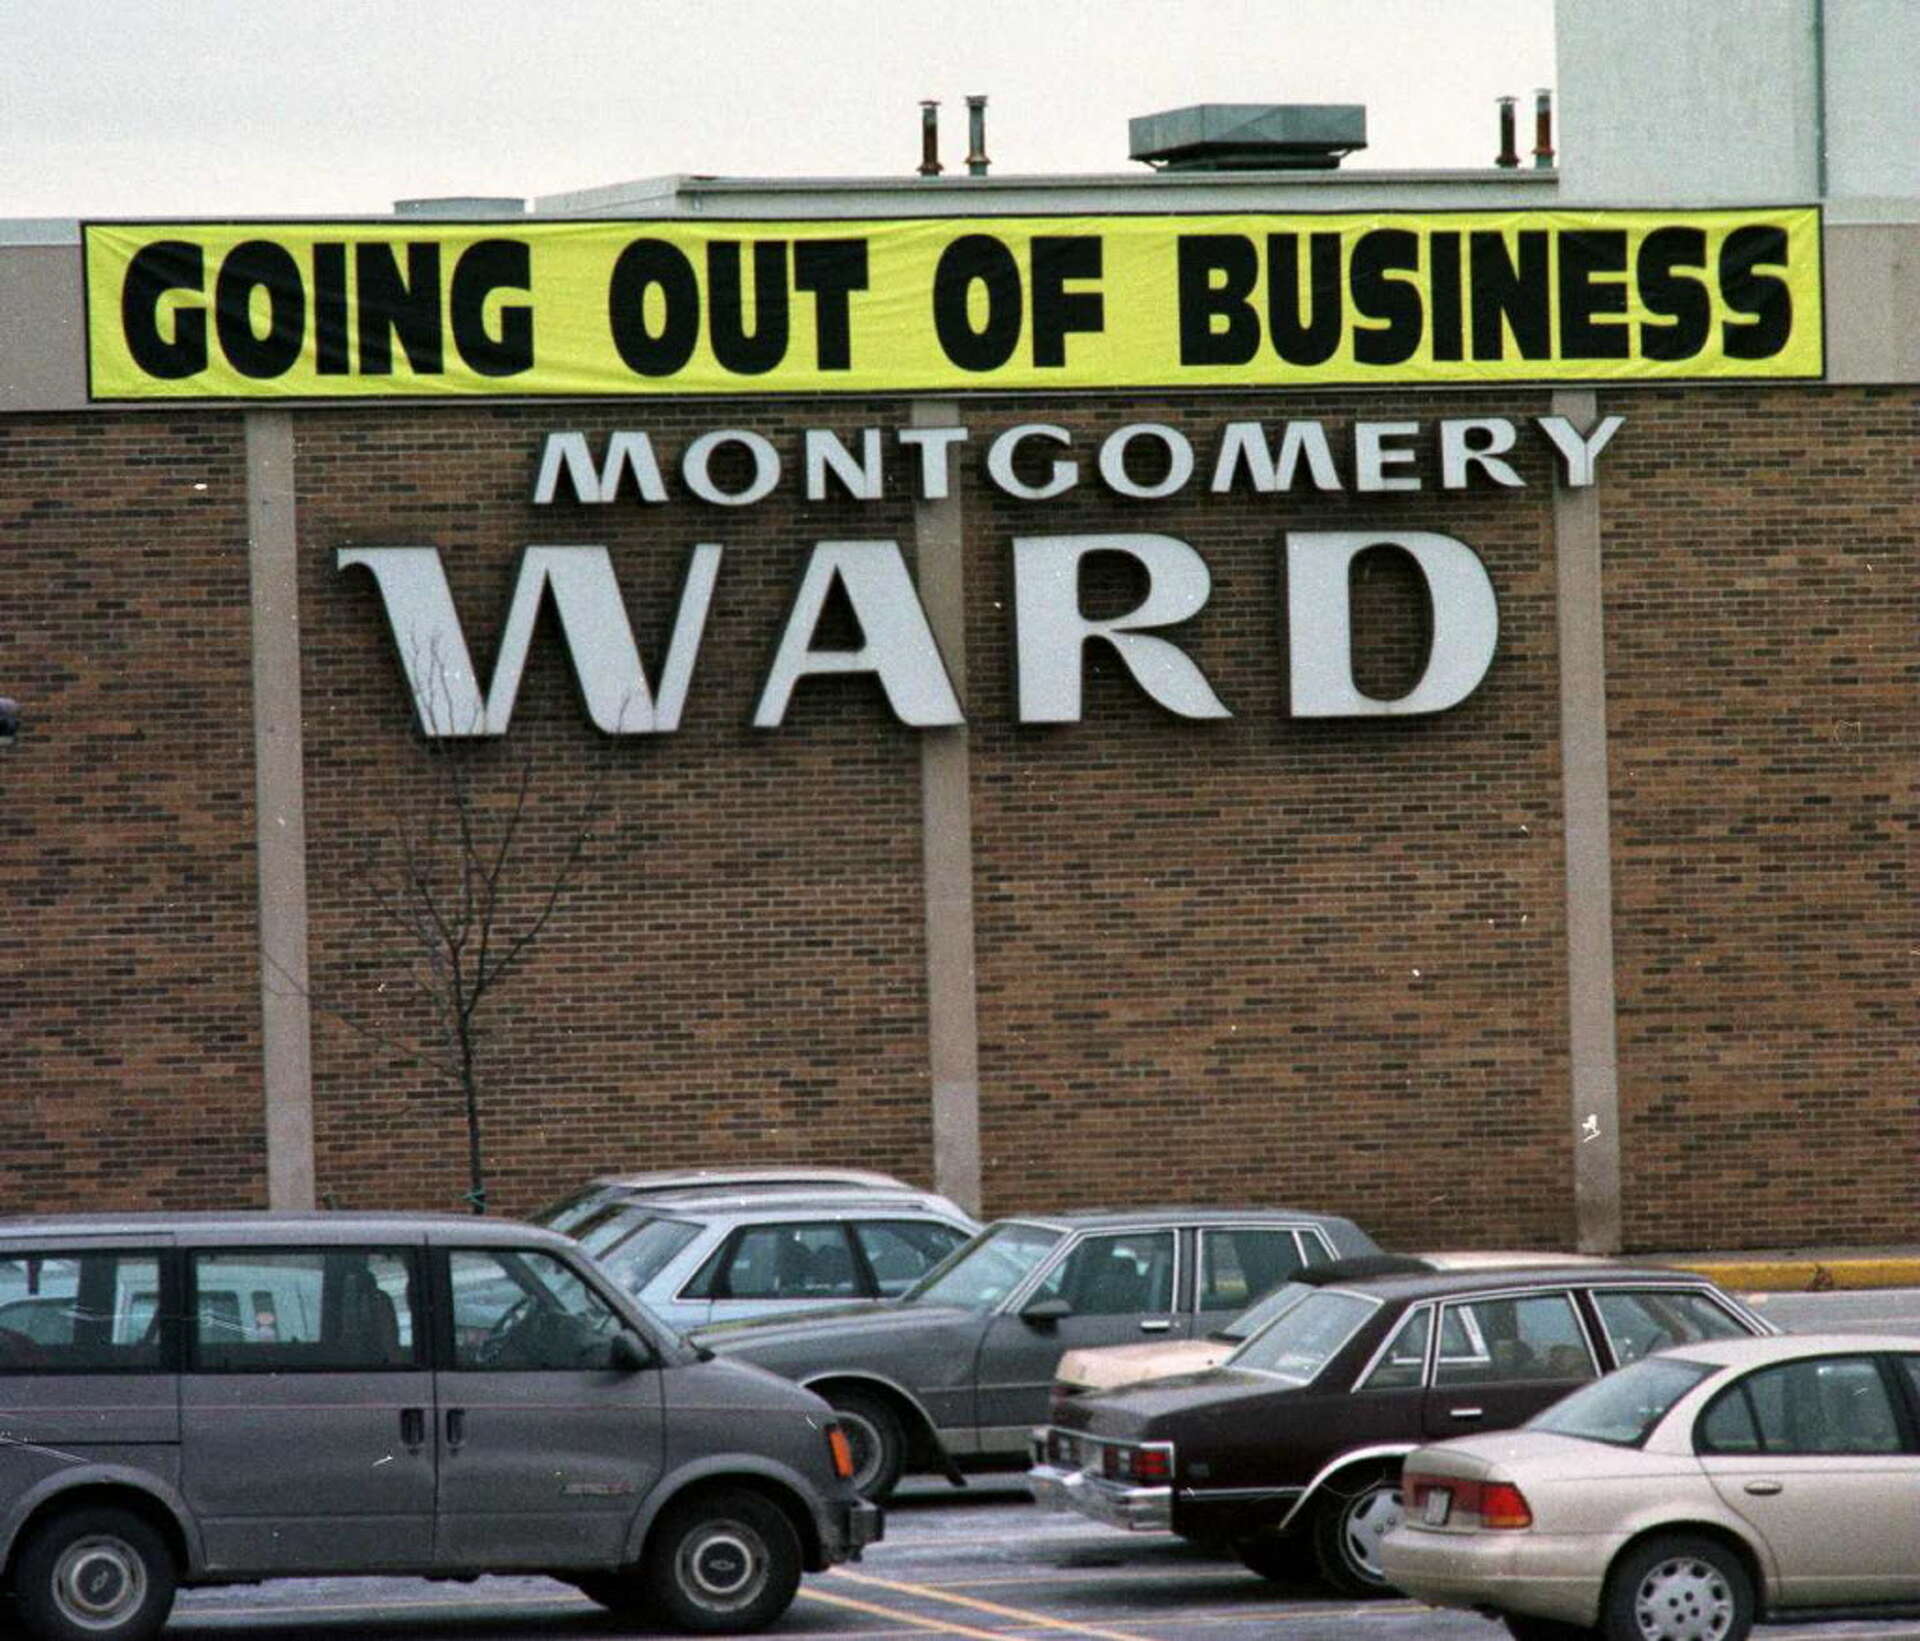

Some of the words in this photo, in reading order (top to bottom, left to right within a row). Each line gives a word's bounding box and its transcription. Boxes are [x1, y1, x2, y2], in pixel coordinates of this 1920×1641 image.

[122, 239, 534, 380] GOING
[609, 237, 869, 378] OUT
[933, 233, 1104, 372] OF
[1177, 225, 1793, 367] BUSINESS
[533, 415, 1626, 506] MONTGOMERY
[336, 530, 1499, 737] WARD
